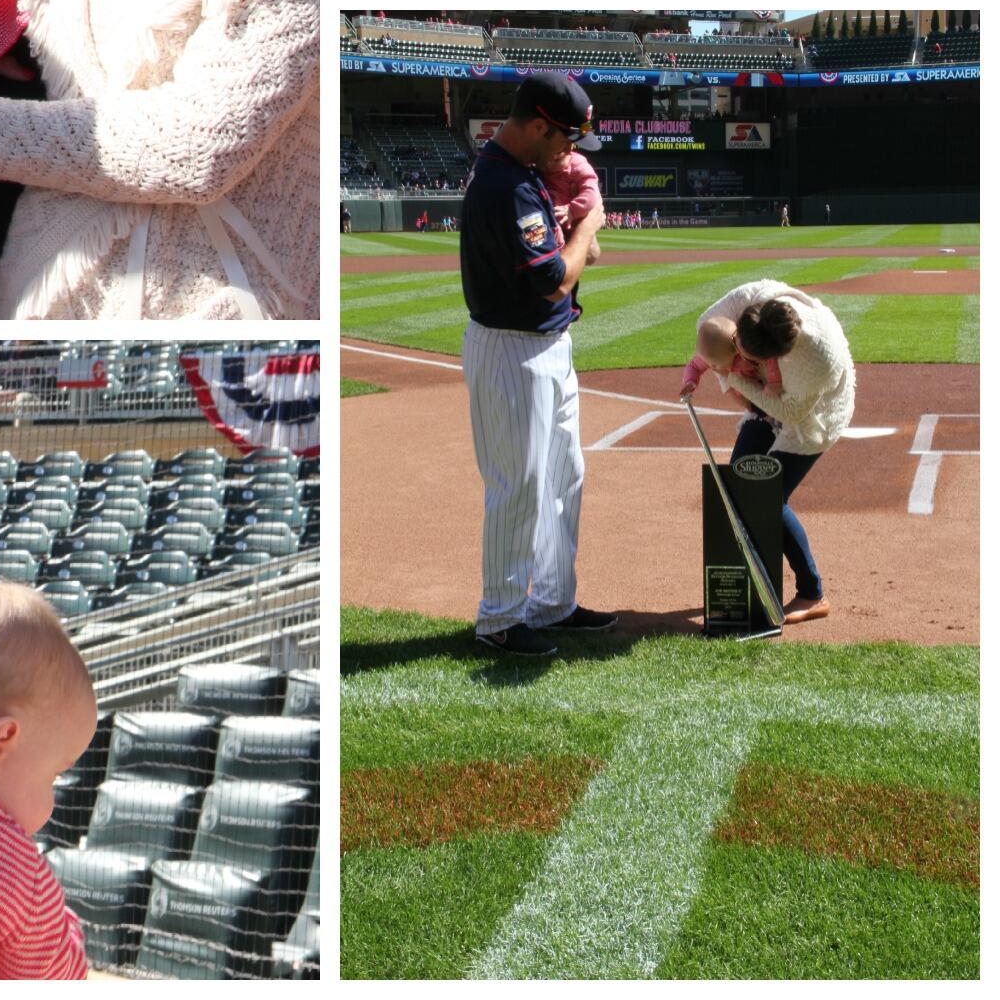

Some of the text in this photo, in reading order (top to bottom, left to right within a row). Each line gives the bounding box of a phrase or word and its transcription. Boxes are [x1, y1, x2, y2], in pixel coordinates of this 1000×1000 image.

[843, 73, 878, 84] PRESENTED
[916, 68, 980, 81] SUPERAMERI
[599, 120, 631, 133] MEDIA
[619, 174, 669, 188] SUBWAY
